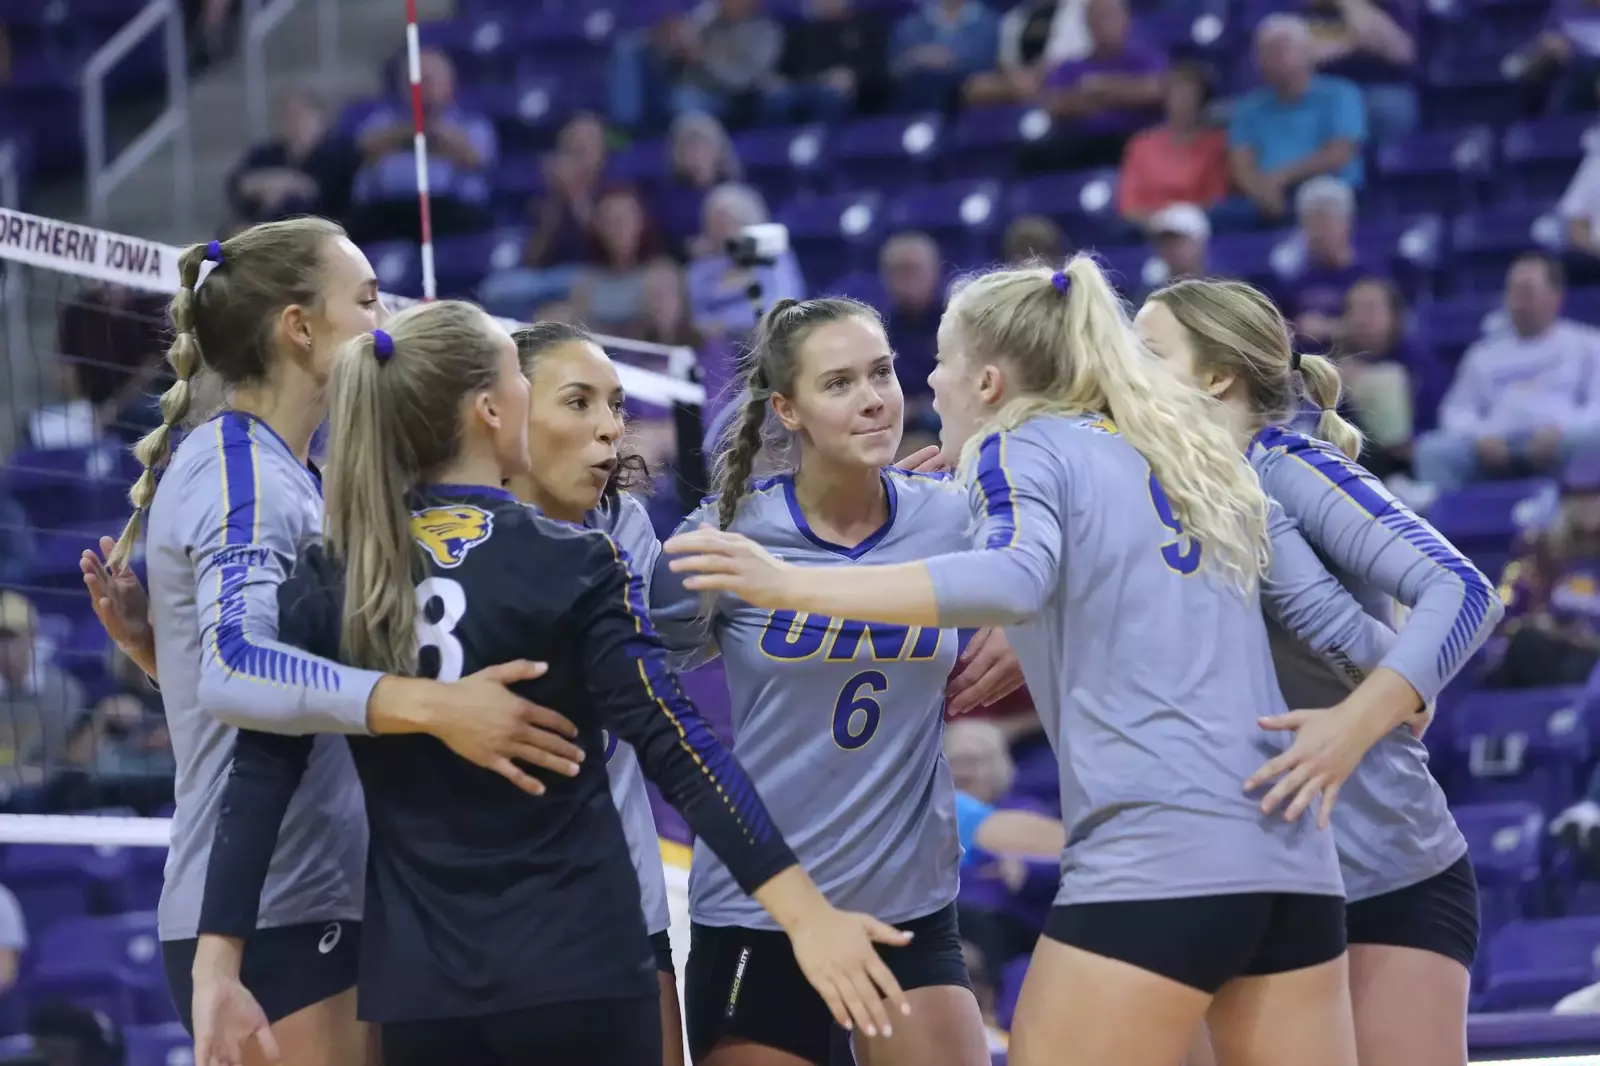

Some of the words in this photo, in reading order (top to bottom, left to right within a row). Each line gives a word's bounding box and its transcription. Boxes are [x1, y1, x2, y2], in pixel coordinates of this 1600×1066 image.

[106, 238, 161, 278] IOWA
[412, 577, 467, 684] 8
[831, 668, 889, 751] 6
